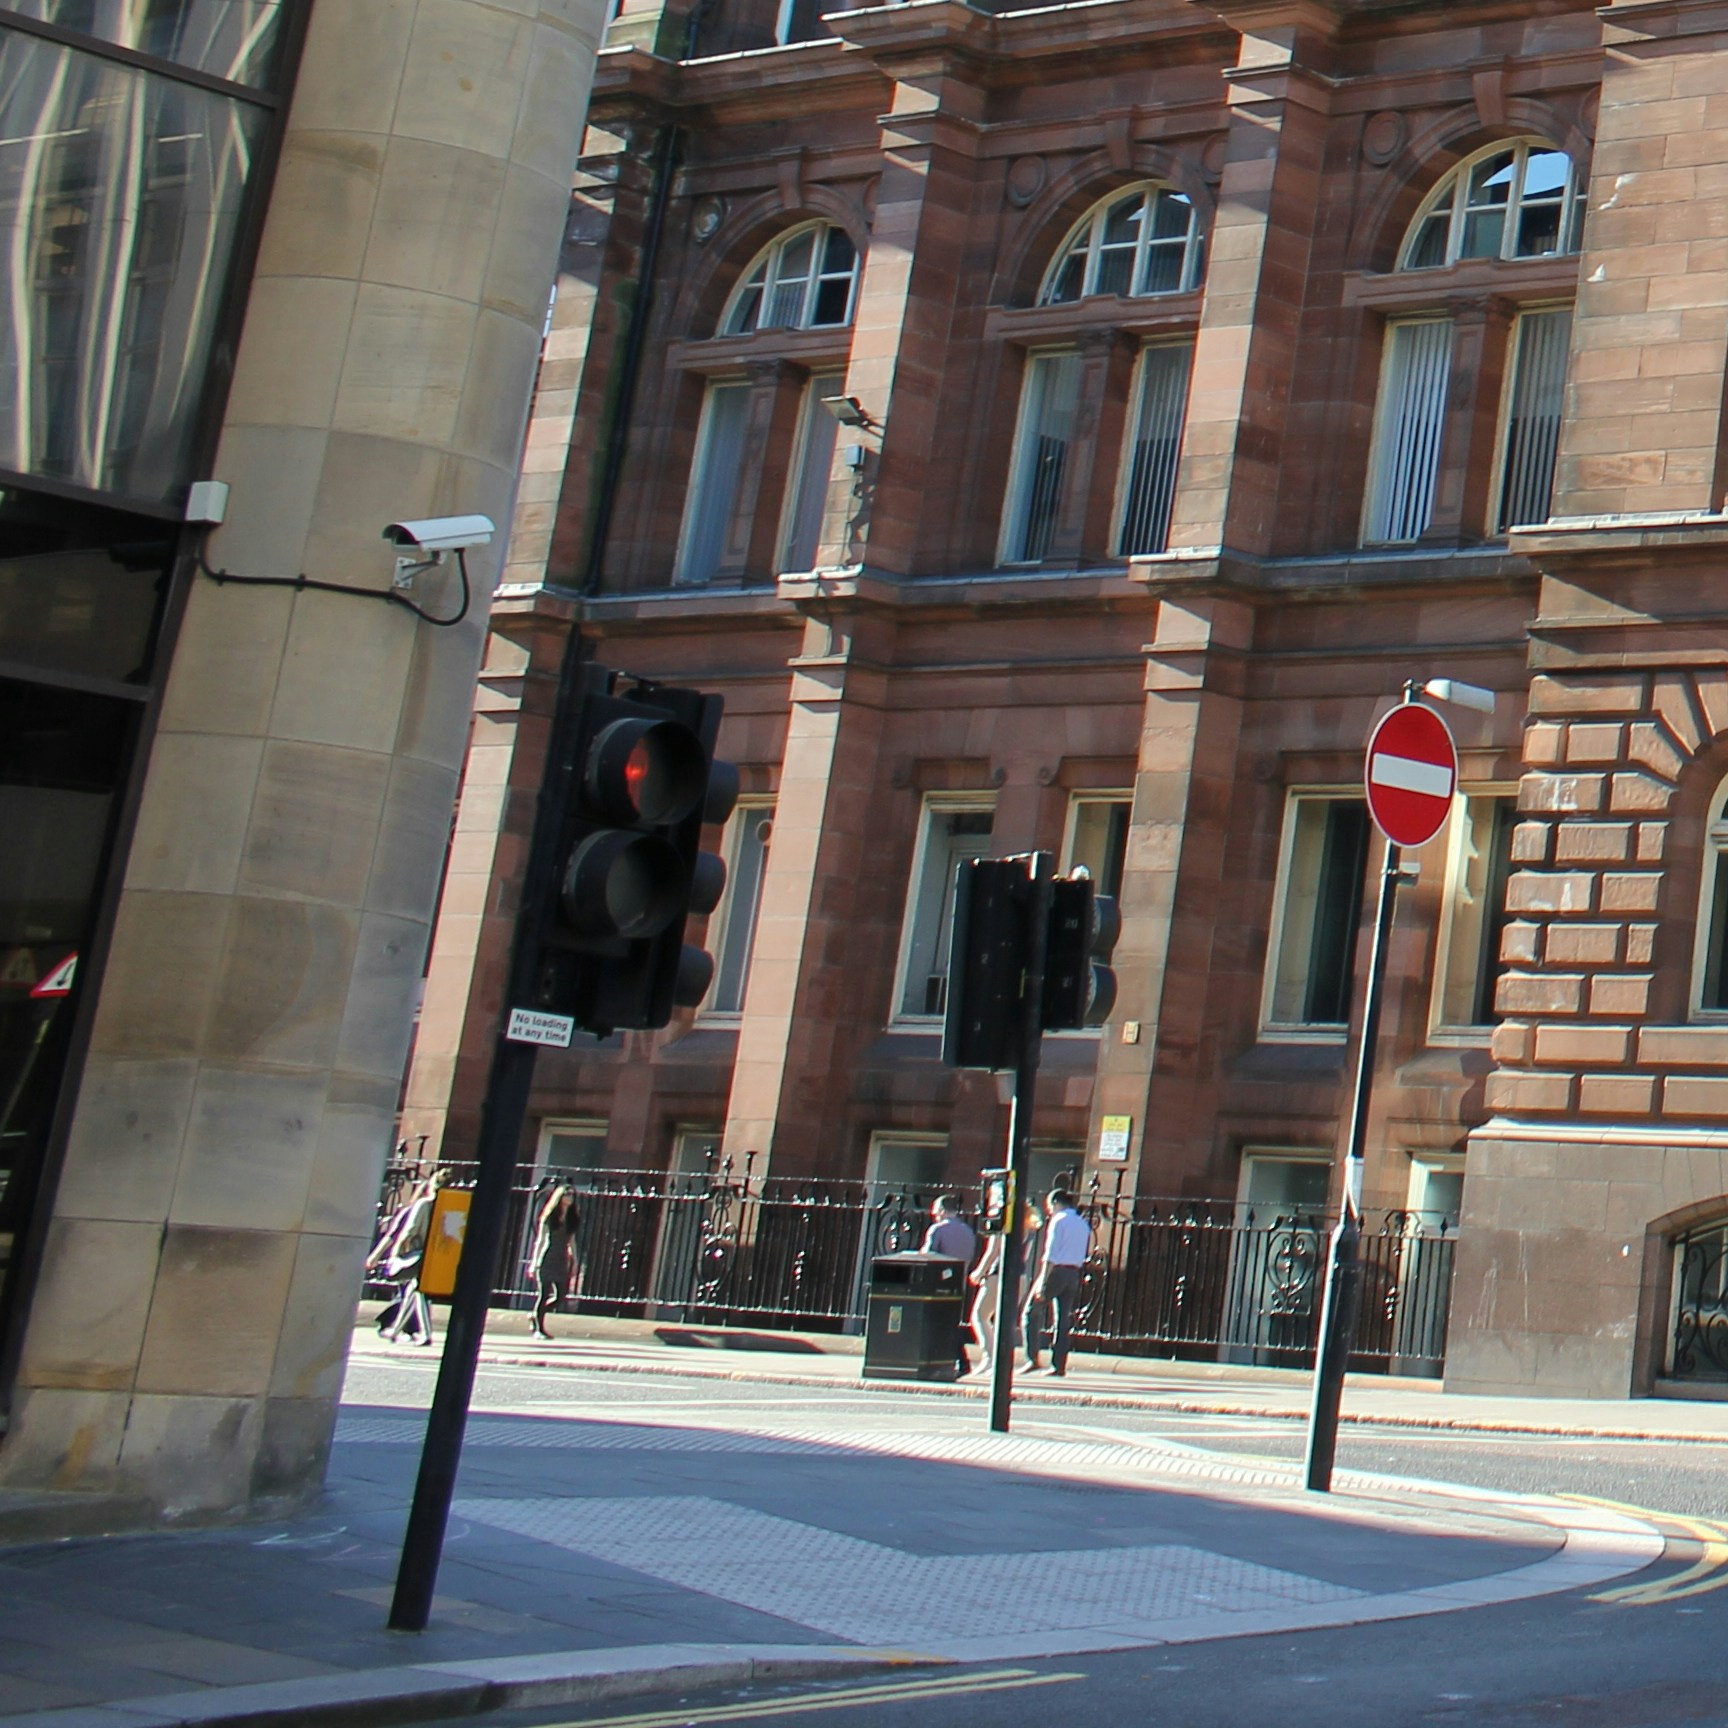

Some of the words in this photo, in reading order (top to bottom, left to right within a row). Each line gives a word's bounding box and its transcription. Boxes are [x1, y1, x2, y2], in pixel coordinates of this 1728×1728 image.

[515, 1013, 530, 1024] No
[532, 1016, 568, 1032] loading
[511, 1026, 522, 1035] at
[525, 1029, 542, 1040] any
[545, 1030, 567, 1042] time
